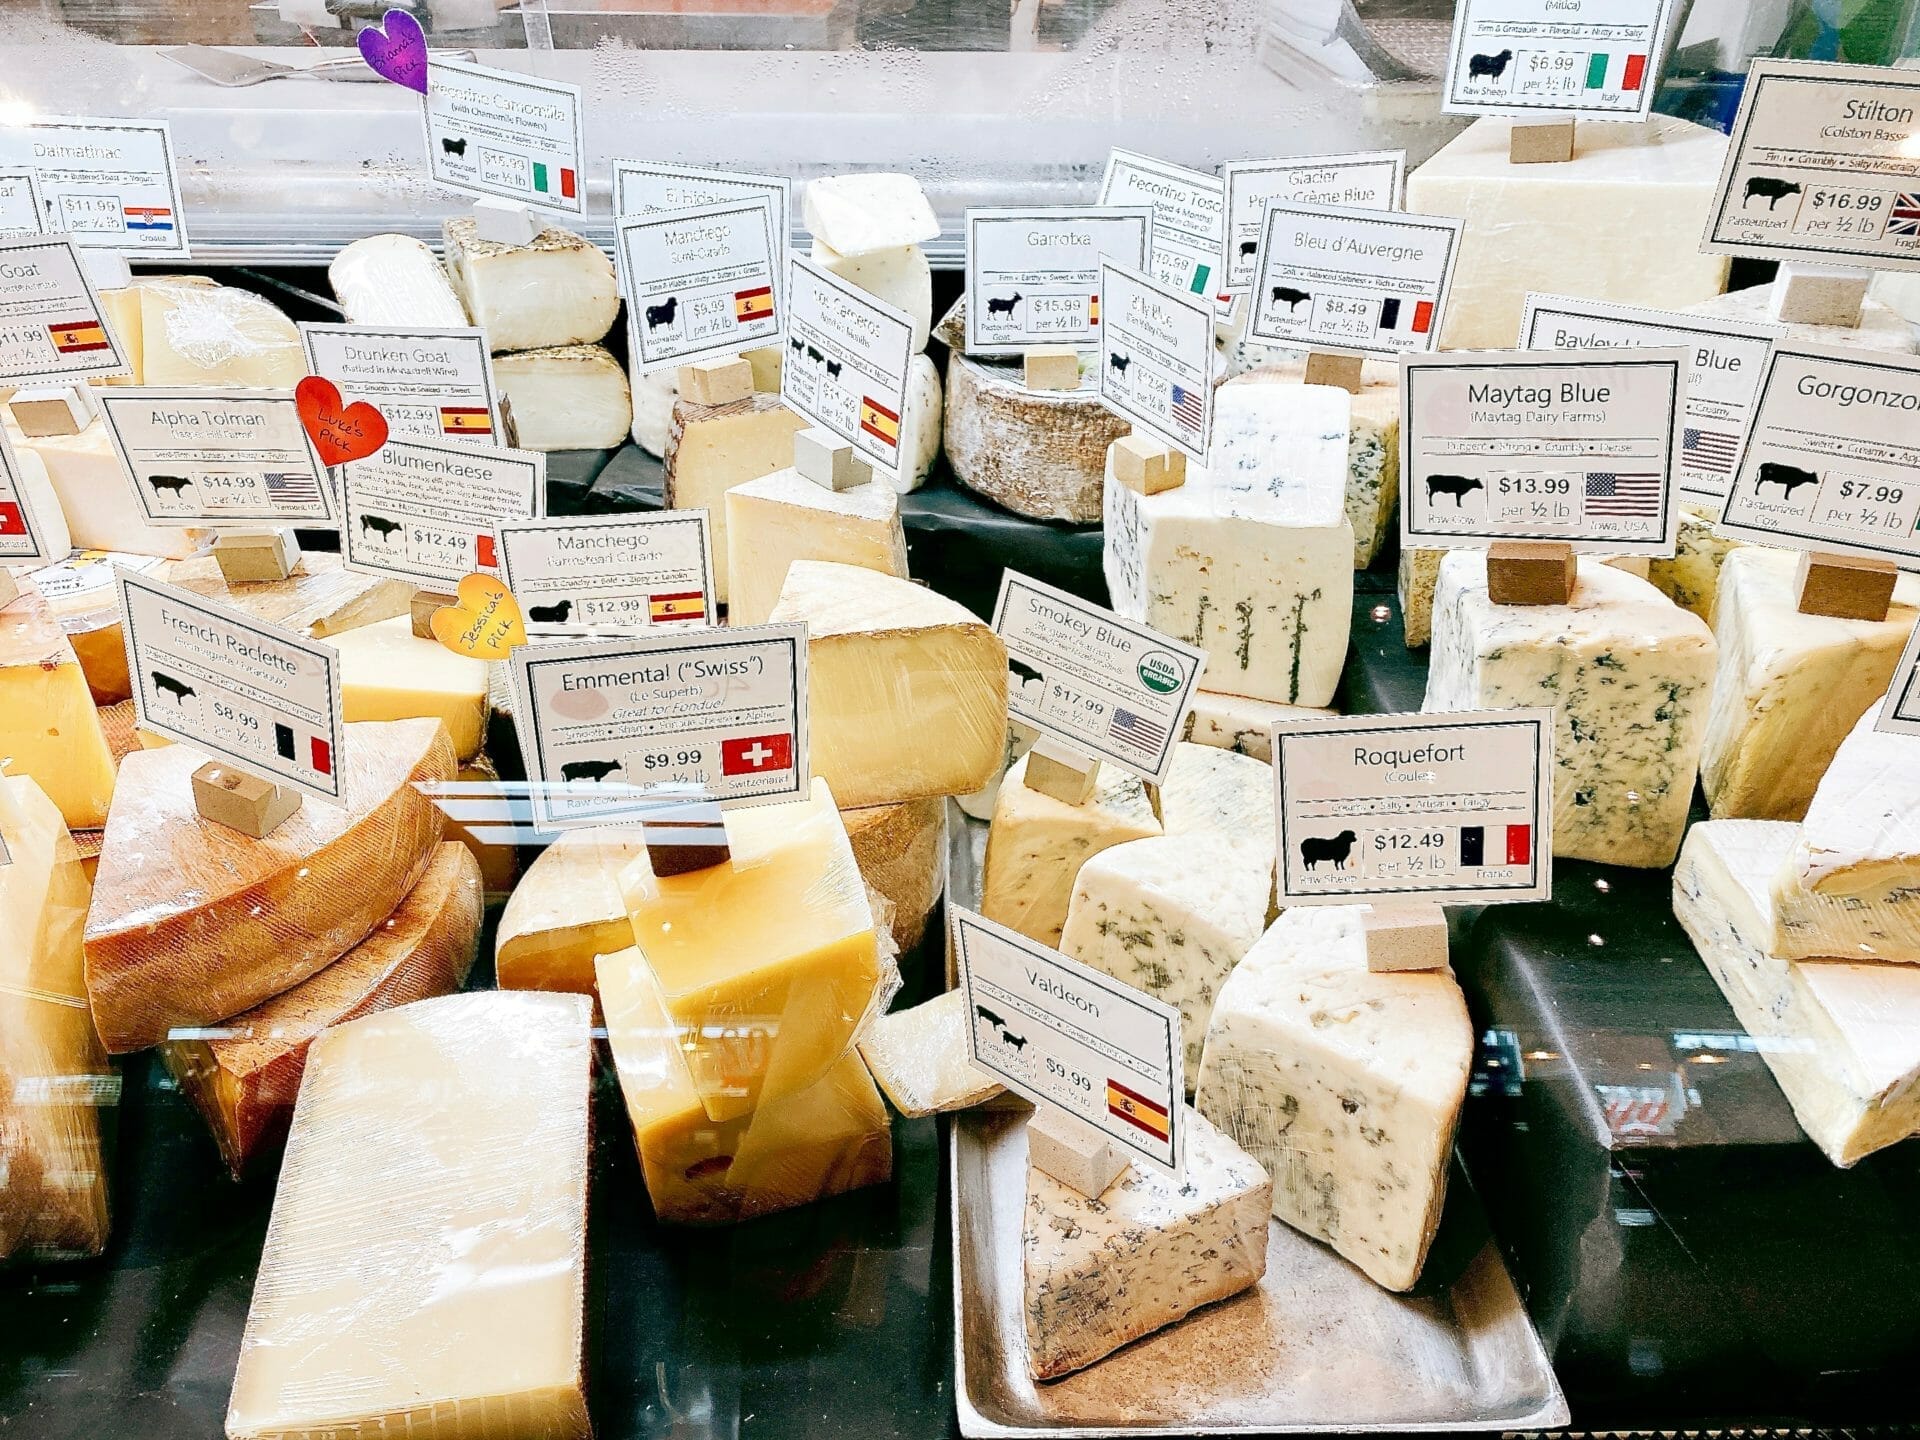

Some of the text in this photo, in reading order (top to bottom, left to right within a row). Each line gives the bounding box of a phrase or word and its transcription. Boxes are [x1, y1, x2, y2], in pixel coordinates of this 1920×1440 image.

[1478, 24, 1494, 33] Firm
[1624, 29, 1643, 38] Salty
[1529, 56, 1573, 72] $6.99
[1462, 86, 1507, 98] Raw Sheep
[1523, 77, 1576, 92] per lb
[1601, 92, 1620, 103] Italy
[1843, 100, 1913, 124] Stilton
[1821, 126, 1871, 140] (Colston
[1798, 155, 1837, 167] Crumbly
[1849, 159, 1871, 171] Salty
[485, 171, 526, 187] per lb
[1288, 170, 1338, 185] Glacier
[1128, 174, 1186, 202] Pecorino
[1344, 188, 1375, 201] Blue
[65, 200, 116, 213] $11.99
[1812, 191, 1881, 211] $16.99
[71, 221, 91, 233] per
[1727, 215, 1788, 229] Pasteurized
[1807, 220, 1831, 232] per
[1858, 217, 1874, 233] lb
[1027, 232, 1091, 246] Garrotxa
[1742, 230, 1764, 241] Cow
[1294, 231, 1424, 262] Bleu d'Auvergne
[0, 262, 41, 280] Goat
[1034, 300, 1081, 313] $15.99
[1325, 299, 1367, 315] $8.49
[719, 316, 732, 329] lb
[1036, 316, 1082, 331] per lb
[1357, 322, 1369, 334] lb
[0, 329, 43, 348] 11.99
[344, 346, 451, 364] Drunken Goat
[1695, 349, 1741, 372] Blue
[1468, 382, 1610, 408] Maytag Blue
[151, 410, 266, 430] Alpha Tolman
[385, 408, 433, 421] $12.99
[1471, 410, 1606, 426] (Maytag Dairy Farms)
[382, 450, 493, 481] Blumenkaese
[203, 475, 256, 489] $14.99
[1499, 476, 1569, 497] $13.99
[1839, 480, 1903, 504] $7.99
[1501, 505, 1523, 518] per
[1553, 501, 1569, 517] lb
[1739, 496, 1806, 517] Pasteurized
[1754, 514, 1780, 527] Cow
[1826, 508, 1852, 521] per
[1884, 511, 1902, 529] lb
[1590, 522, 1649, 534] Iowa, USA
[414, 530, 467, 549] $12.49
[557, 534, 649, 550] Manchego
[586, 600, 641, 616] $12.99
[1029, 598, 1093, 638] Smokey
[1096, 626, 1132, 654] Blue
[161, 608, 221, 646] French
[226, 635, 297, 676] Raclette
[1149, 658, 1175, 676] USDA
[562, 663, 671, 692] Emmental
[1142, 668, 1176, 689] ORGANIC
[1053, 685, 1104, 715] $17.99
[214, 701, 259, 731] $8.99
[644, 749, 702, 770] $9.99
[1354, 743, 1465, 769] Roquefort
[729, 775, 789, 790] Switzerland
[1385, 770, 1430, 783] (Coule
[1374, 832, 1444, 853] $12.49
[1378, 861, 1401, 874] per
[1429, 854, 1445, 871] lb
[1476, 868, 1513, 879] France
[1024, 966, 1101, 1019] Valdeon
[1046, 1057, 1092, 1092] $9.99
